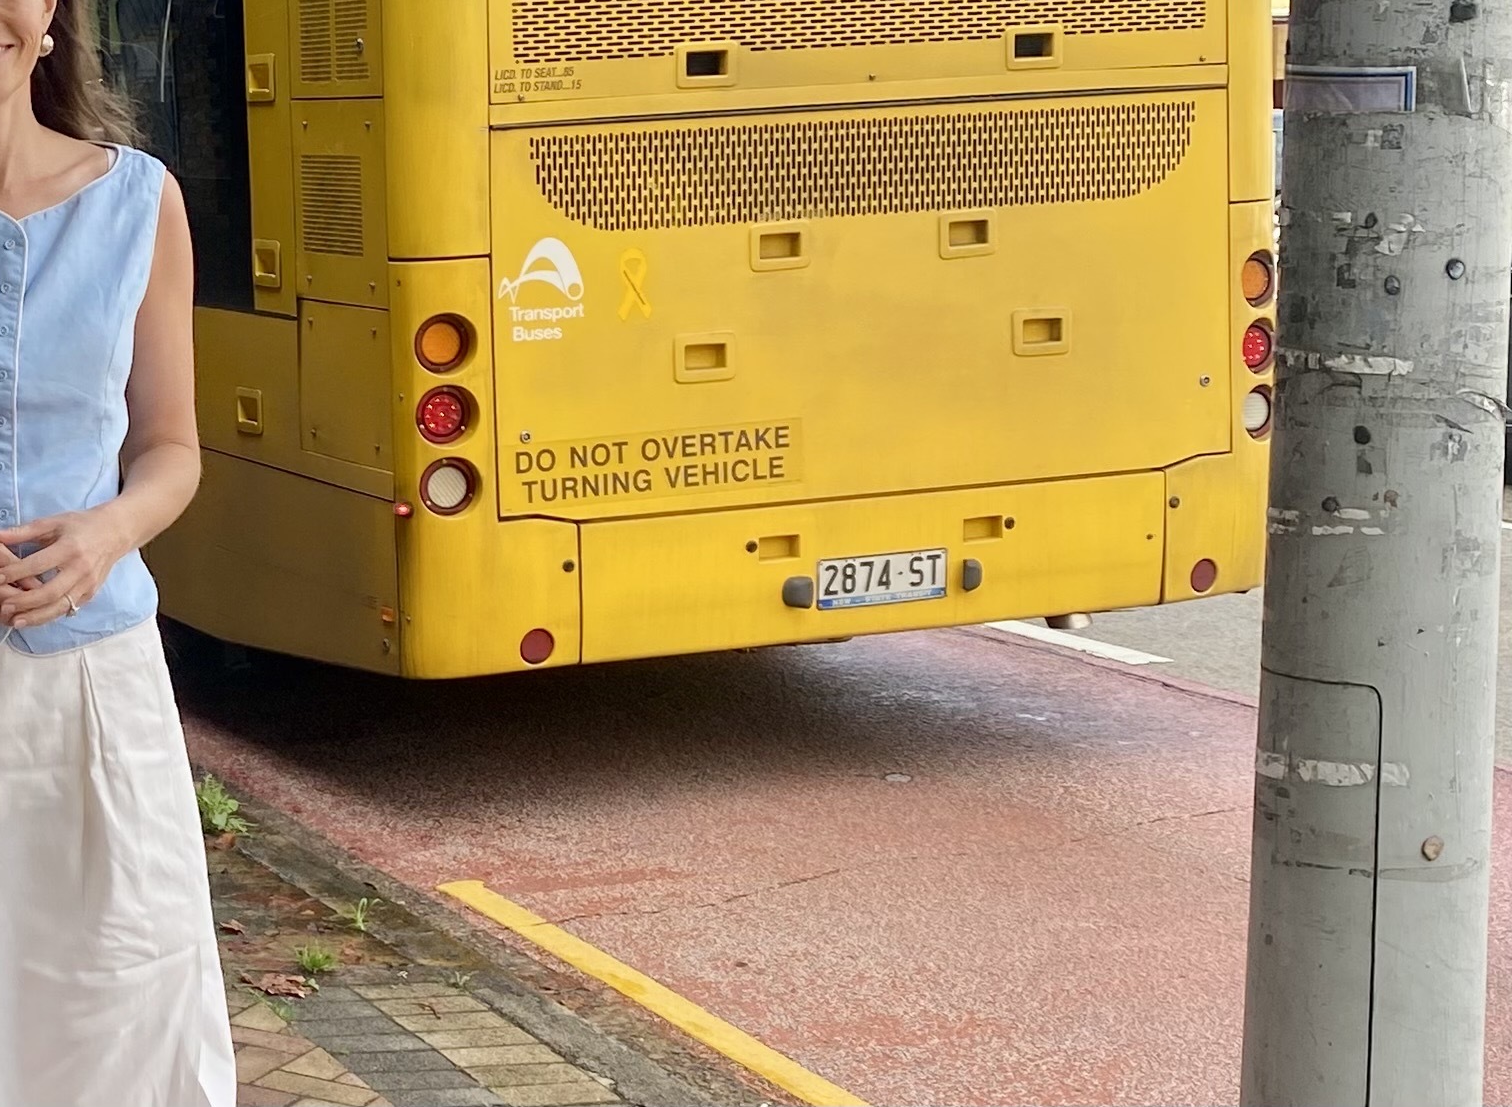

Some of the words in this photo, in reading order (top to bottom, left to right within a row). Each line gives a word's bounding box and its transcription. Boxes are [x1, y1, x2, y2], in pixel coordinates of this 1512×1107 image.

[521, 68, 532, 79] TO
[520, 81, 531, 92] TO
[509, 302, 584, 323] Transport
[512, 325, 563, 342] Buses
[515, 448, 556, 474] DO
[570, 441, 629, 469] NOT
[641, 425, 790, 462] OVERTAKE
[521, 468, 652, 504] TURNING
[663, 455, 785, 489] VEHICLE
